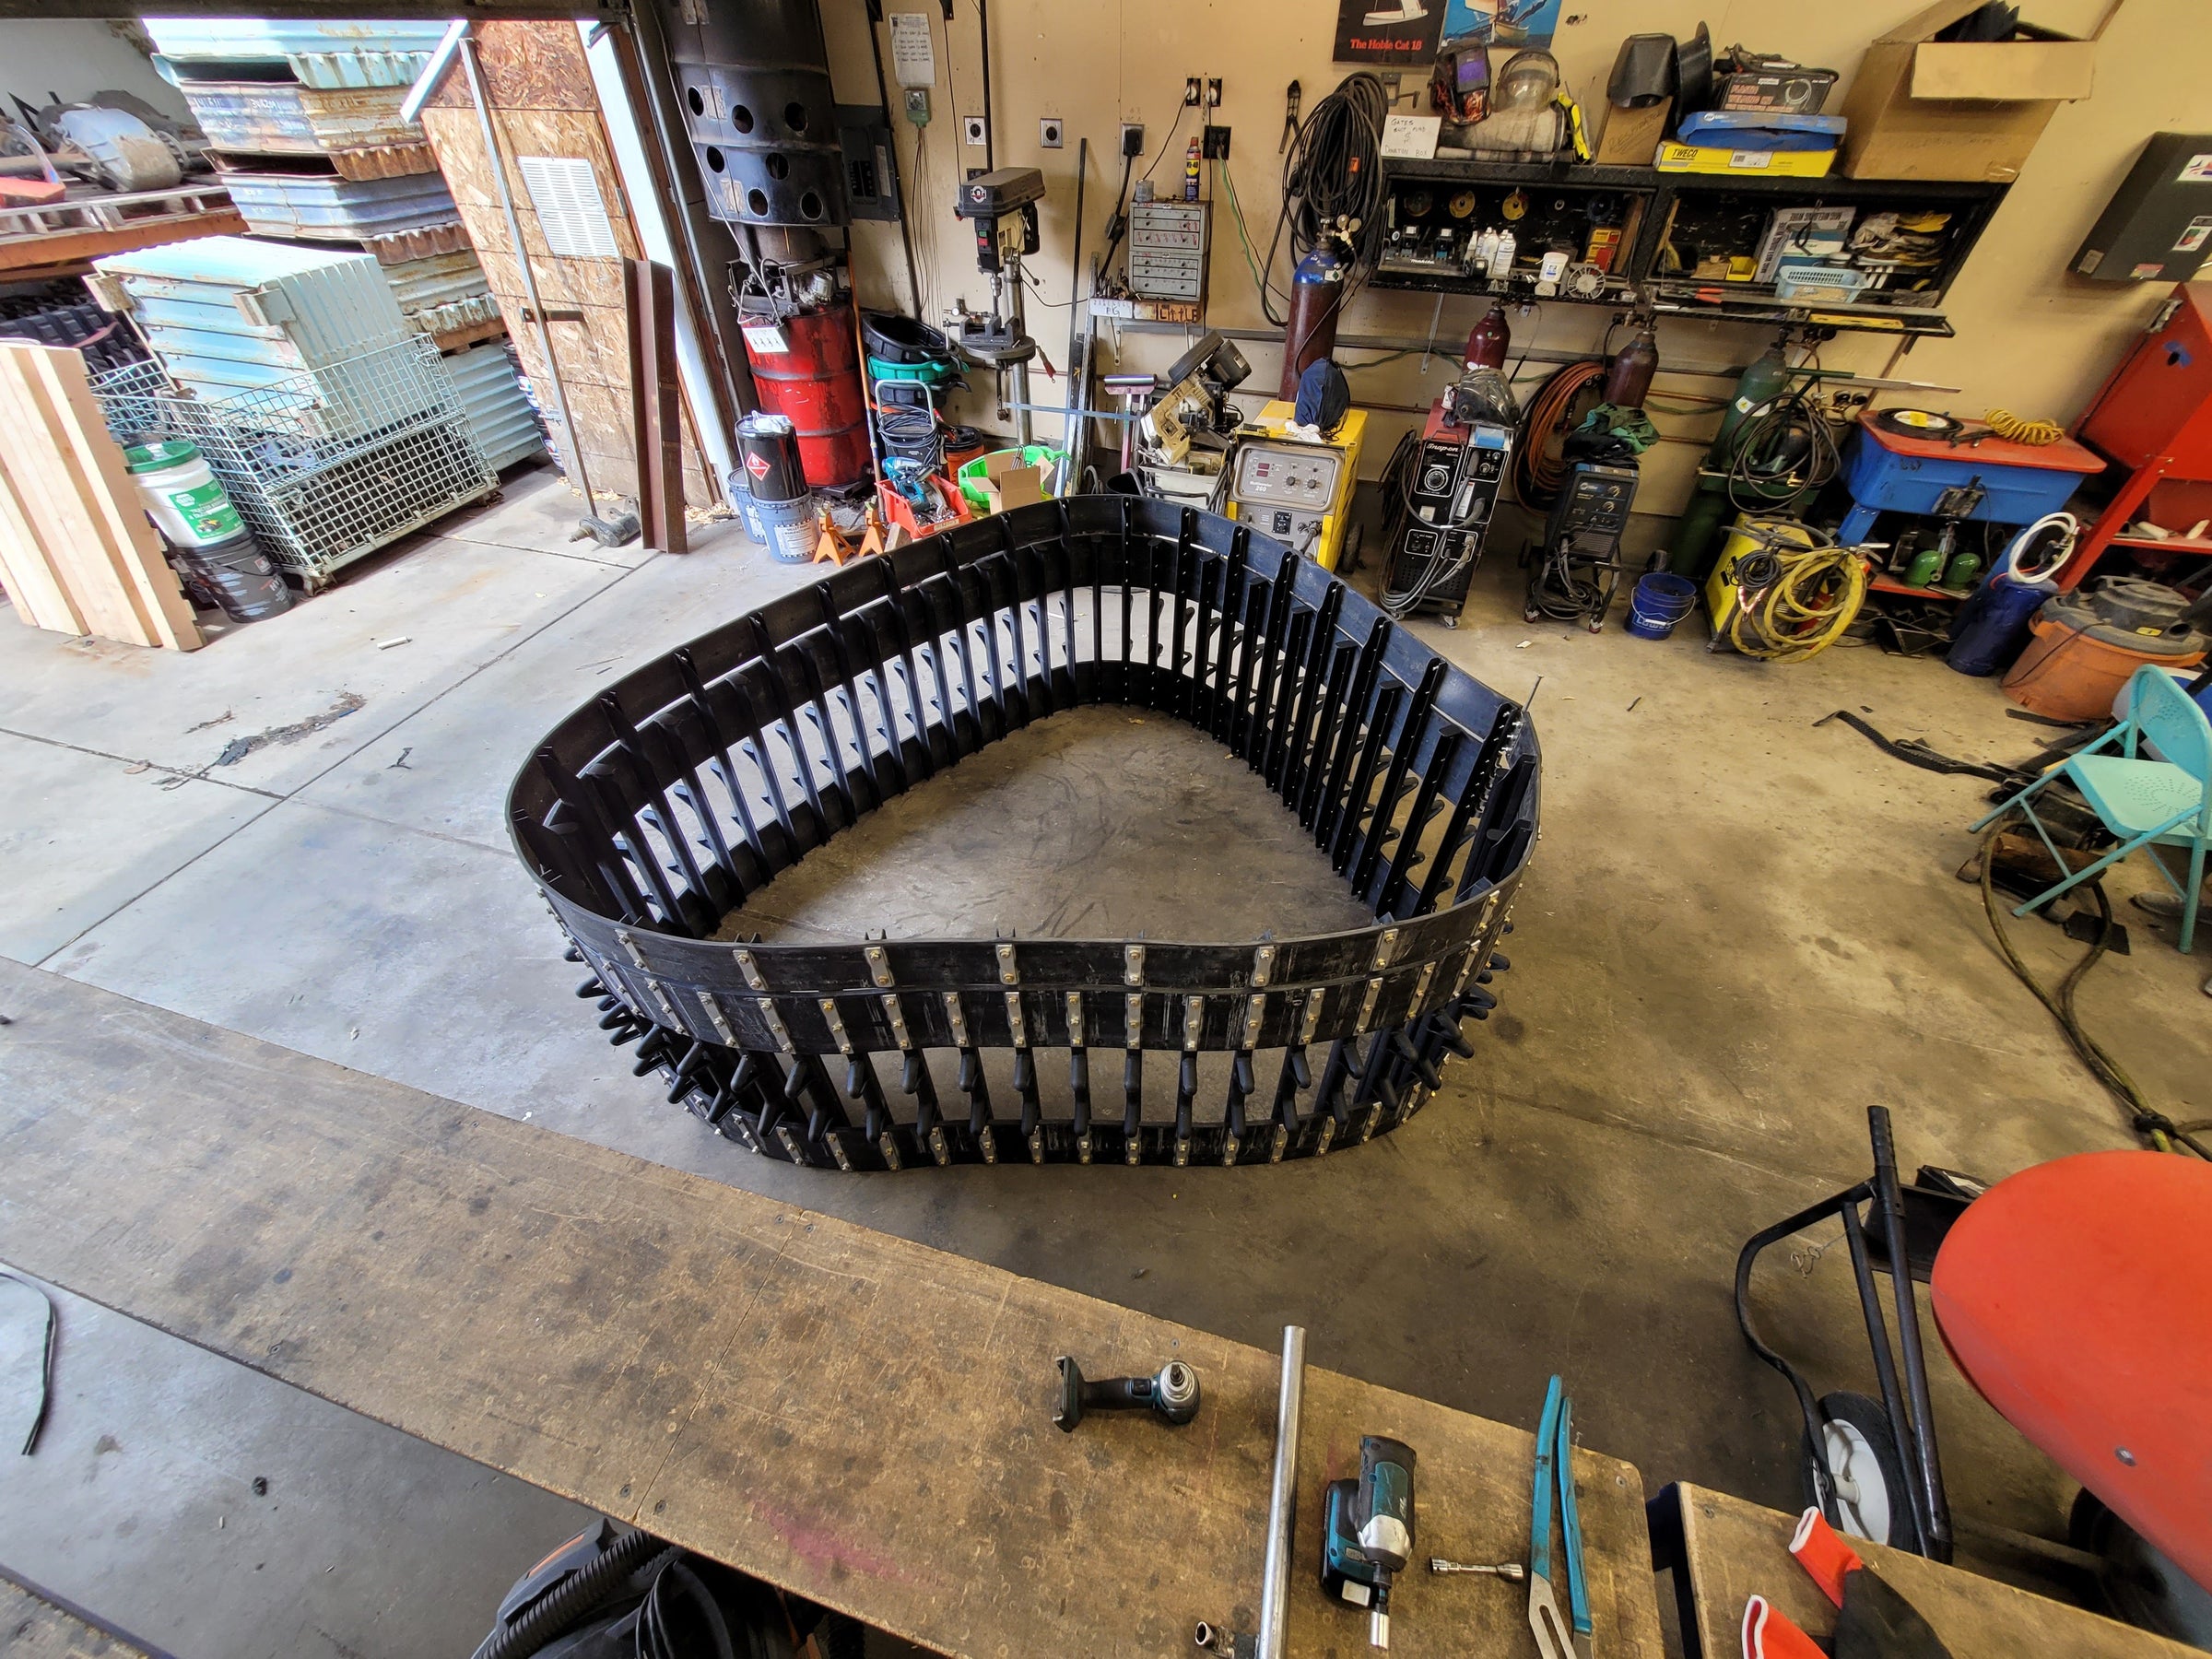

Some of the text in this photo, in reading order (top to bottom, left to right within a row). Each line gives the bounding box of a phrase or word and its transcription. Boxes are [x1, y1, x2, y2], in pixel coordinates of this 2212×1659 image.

[1350, 39, 1422, 51] The Hobie Cat 18
[1672, 148, 1699, 159] TWECO
